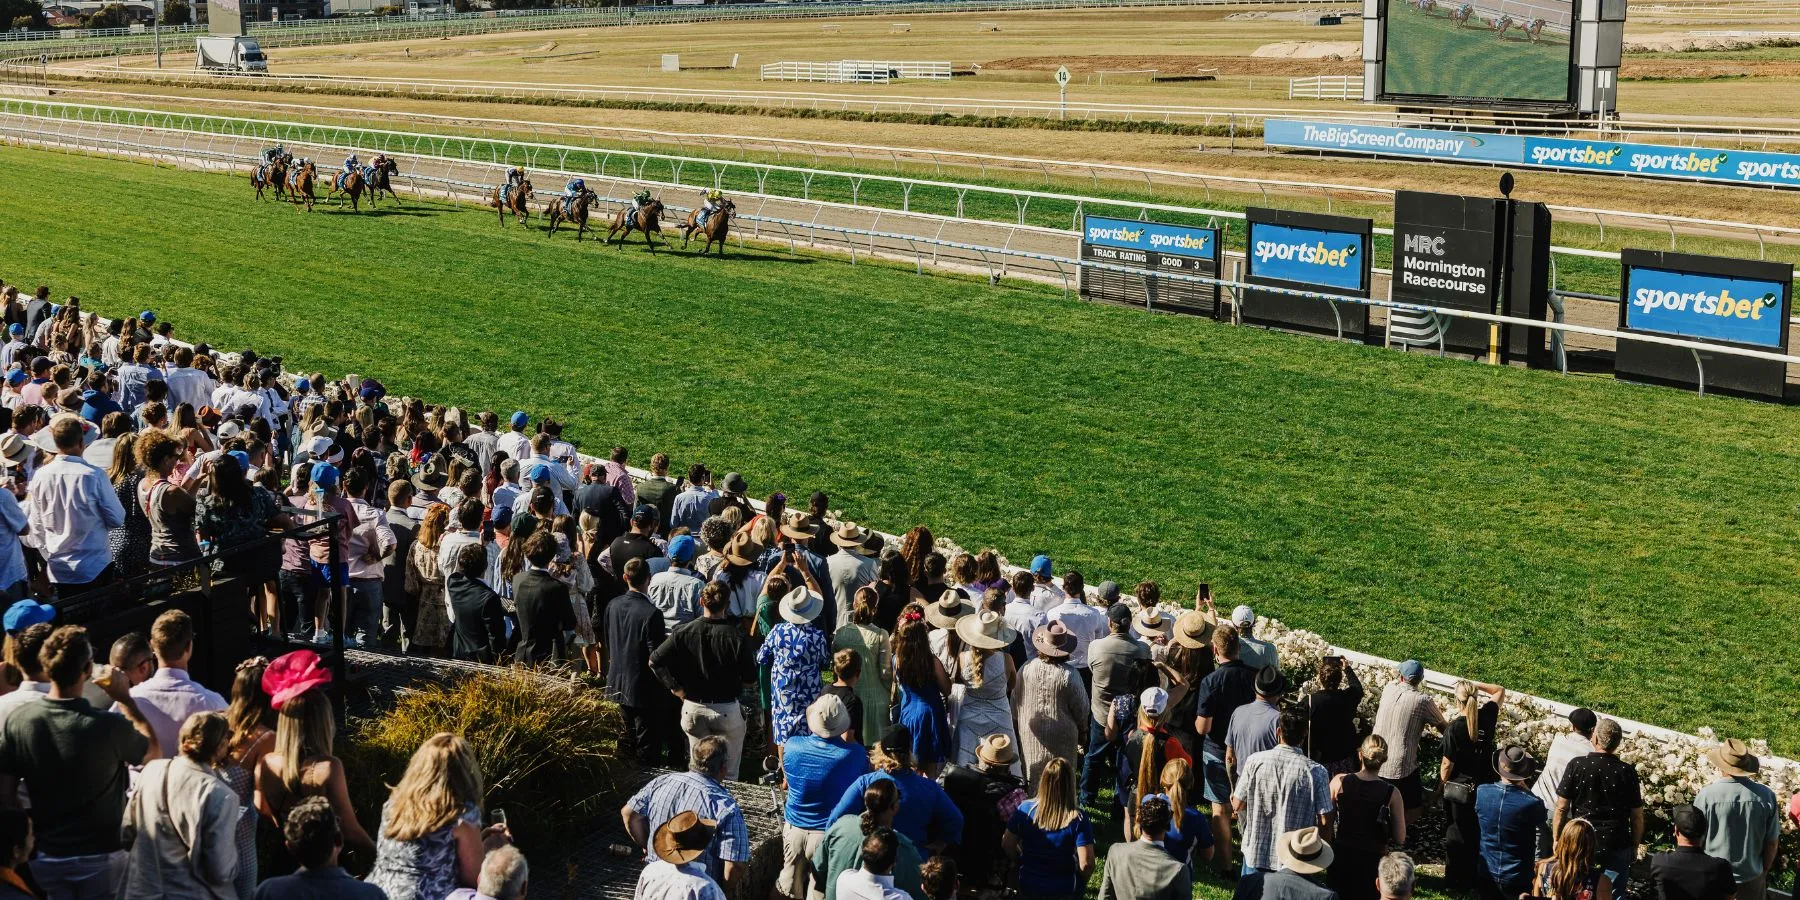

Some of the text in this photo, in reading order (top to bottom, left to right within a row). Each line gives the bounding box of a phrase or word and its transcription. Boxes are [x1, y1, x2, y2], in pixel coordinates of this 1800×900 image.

[41, 54, 47, 63] 2
[1058, 71, 1067, 82] 14
[1303, 125, 1464, 155] TheBigScreenCompany
[1531, 145, 1800, 180] sportsbet sportsbet sports
[1088, 226, 1204, 250] sportsbet sportsbet
[1404, 233, 1446, 256] MRC
[1093, 248, 1200, 270] TRACK RATING GOOD 3
[1254, 240, 1348, 268] sportsbet
[1403, 255, 1486, 278] Mornington
[1403, 271, 1486, 294] Racecourse
[1633, 287, 1765, 320] sportsbet
